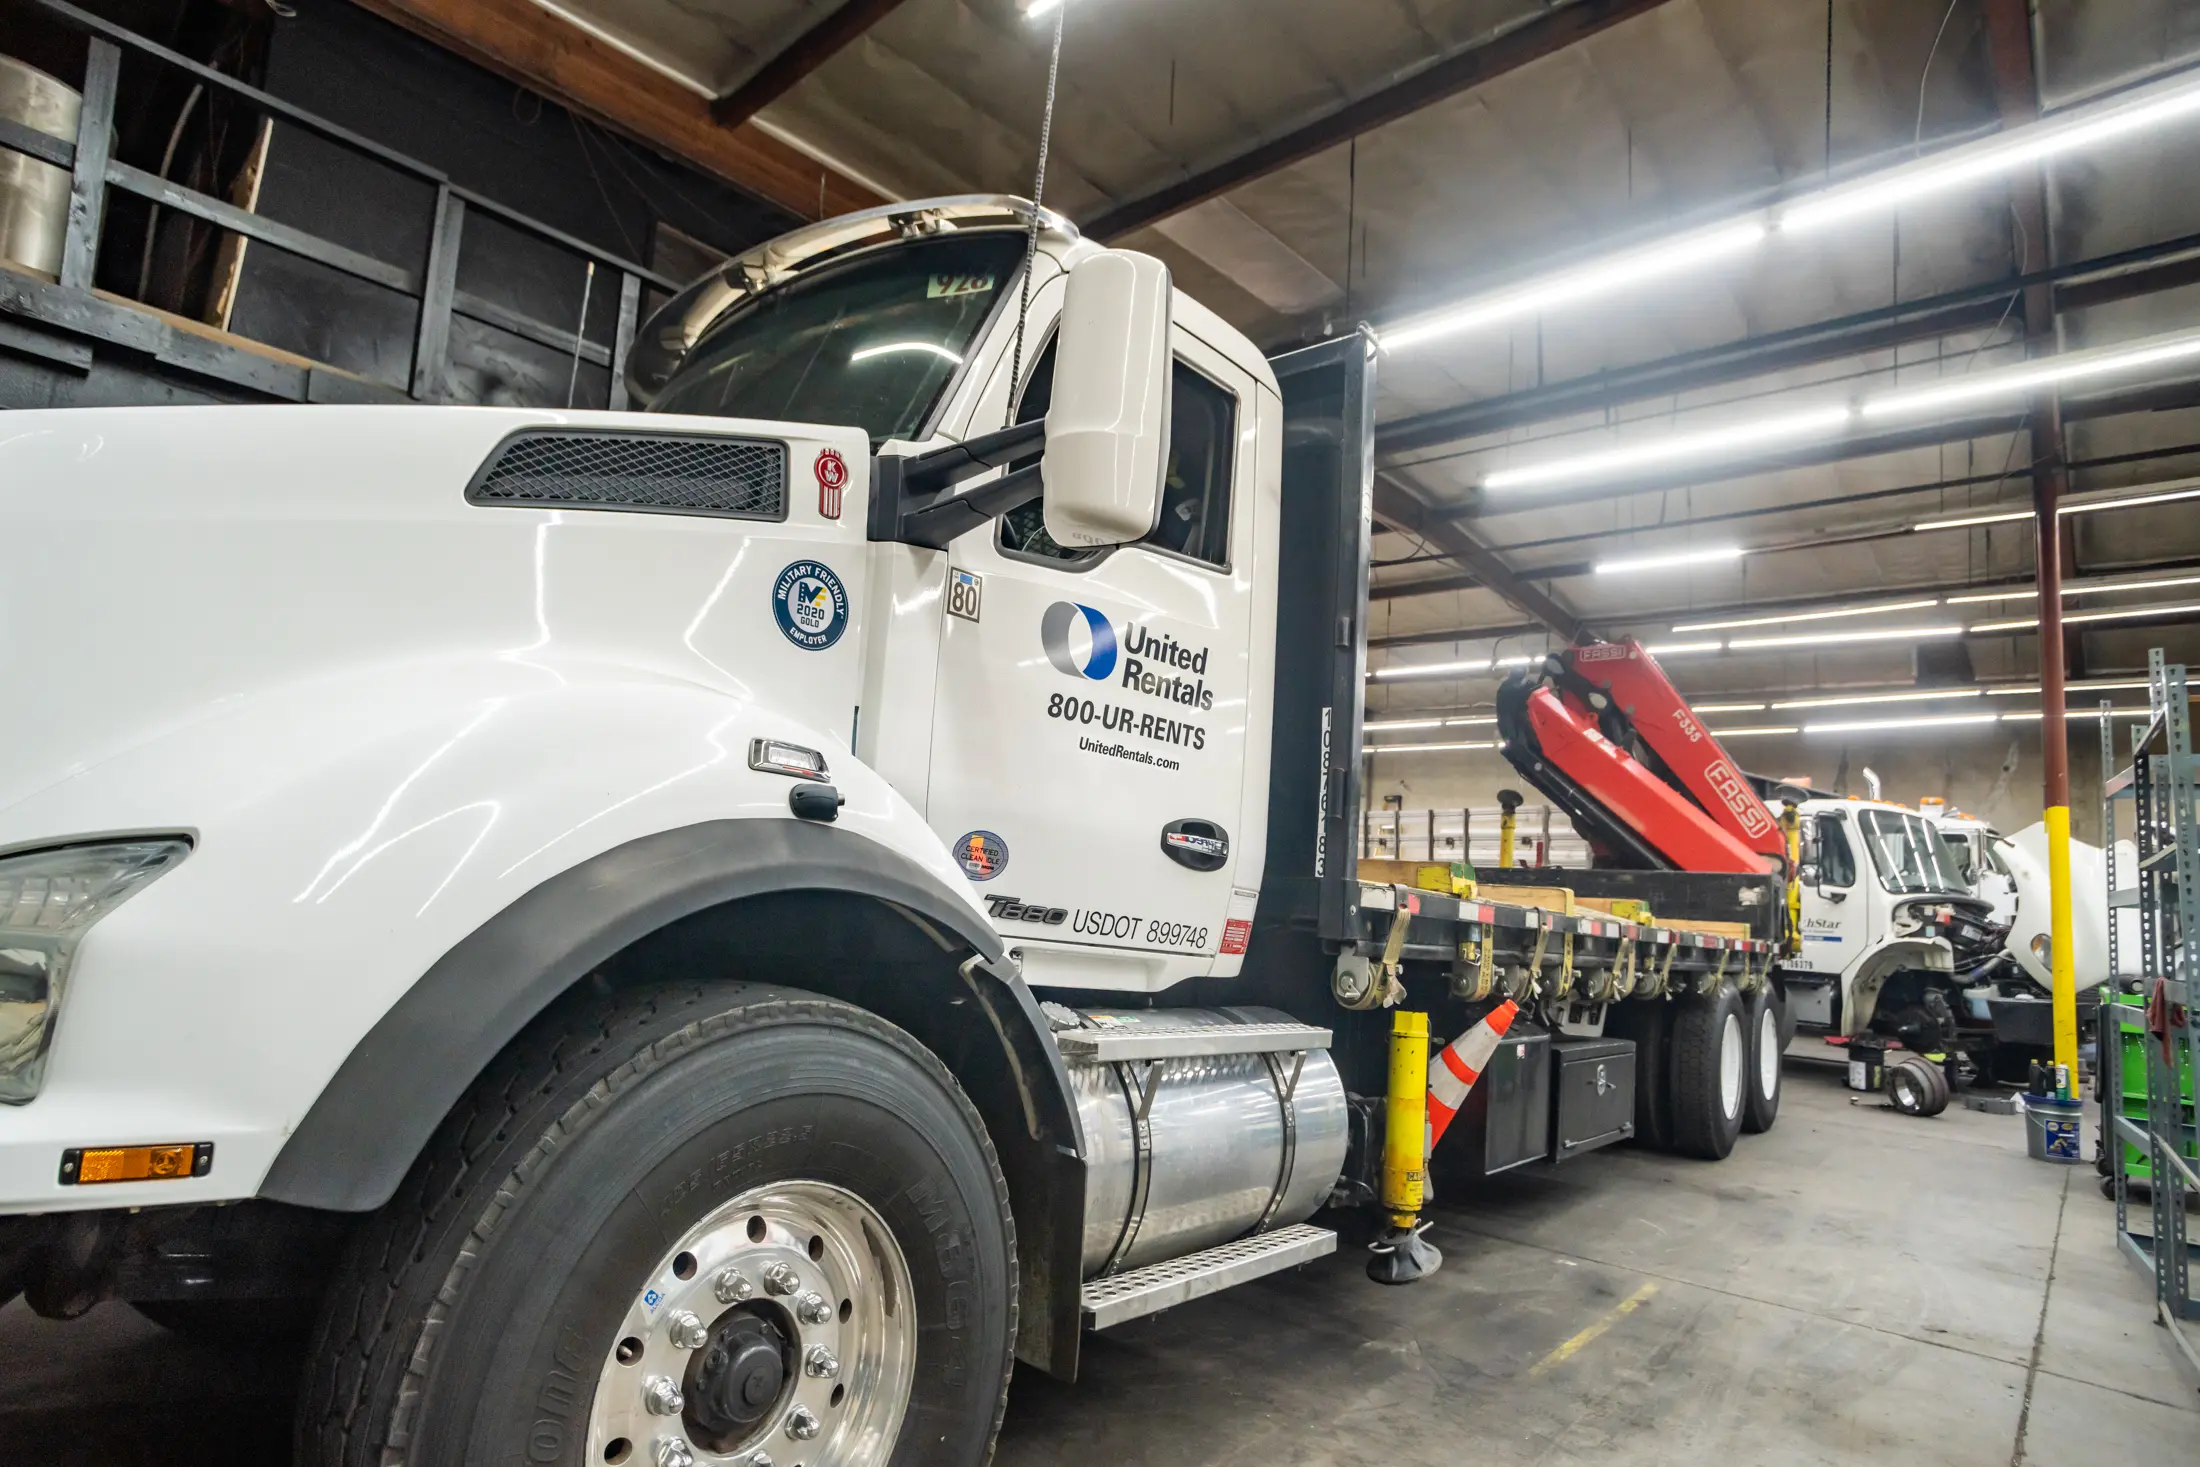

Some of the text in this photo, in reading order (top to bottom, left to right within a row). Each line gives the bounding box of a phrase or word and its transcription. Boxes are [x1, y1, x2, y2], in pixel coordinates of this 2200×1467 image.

[777, 565, 845, 616] MILITARY FRIENDLY
[952, 581, 977, 616] 80
[796, 603, 825, 620] 2020
[800, 616, 820, 628] GOLD
[789, 626, 828, 645] EMPLOYER
[1124, 621, 1209, 676] United
[1583, 647, 1624, 660] FASSI
[1121, 657, 1214, 711] Rentals
[1047, 692, 1206, 751] 800-UR-RENTS
[1079, 736, 1180, 771] UnitedRentals.com
[1709, 765, 1767, 834] FASSI
[960, 852, 984, 862] CLEAN
[965, 845, 999, 857] CERTIFIED
[984, 893, 1069, 925] T880
[1802, 917, 1842, 929] hStar
[1072, 908, 1143, 940] USDOT
[1146, 920, 1208, 949] 899748
